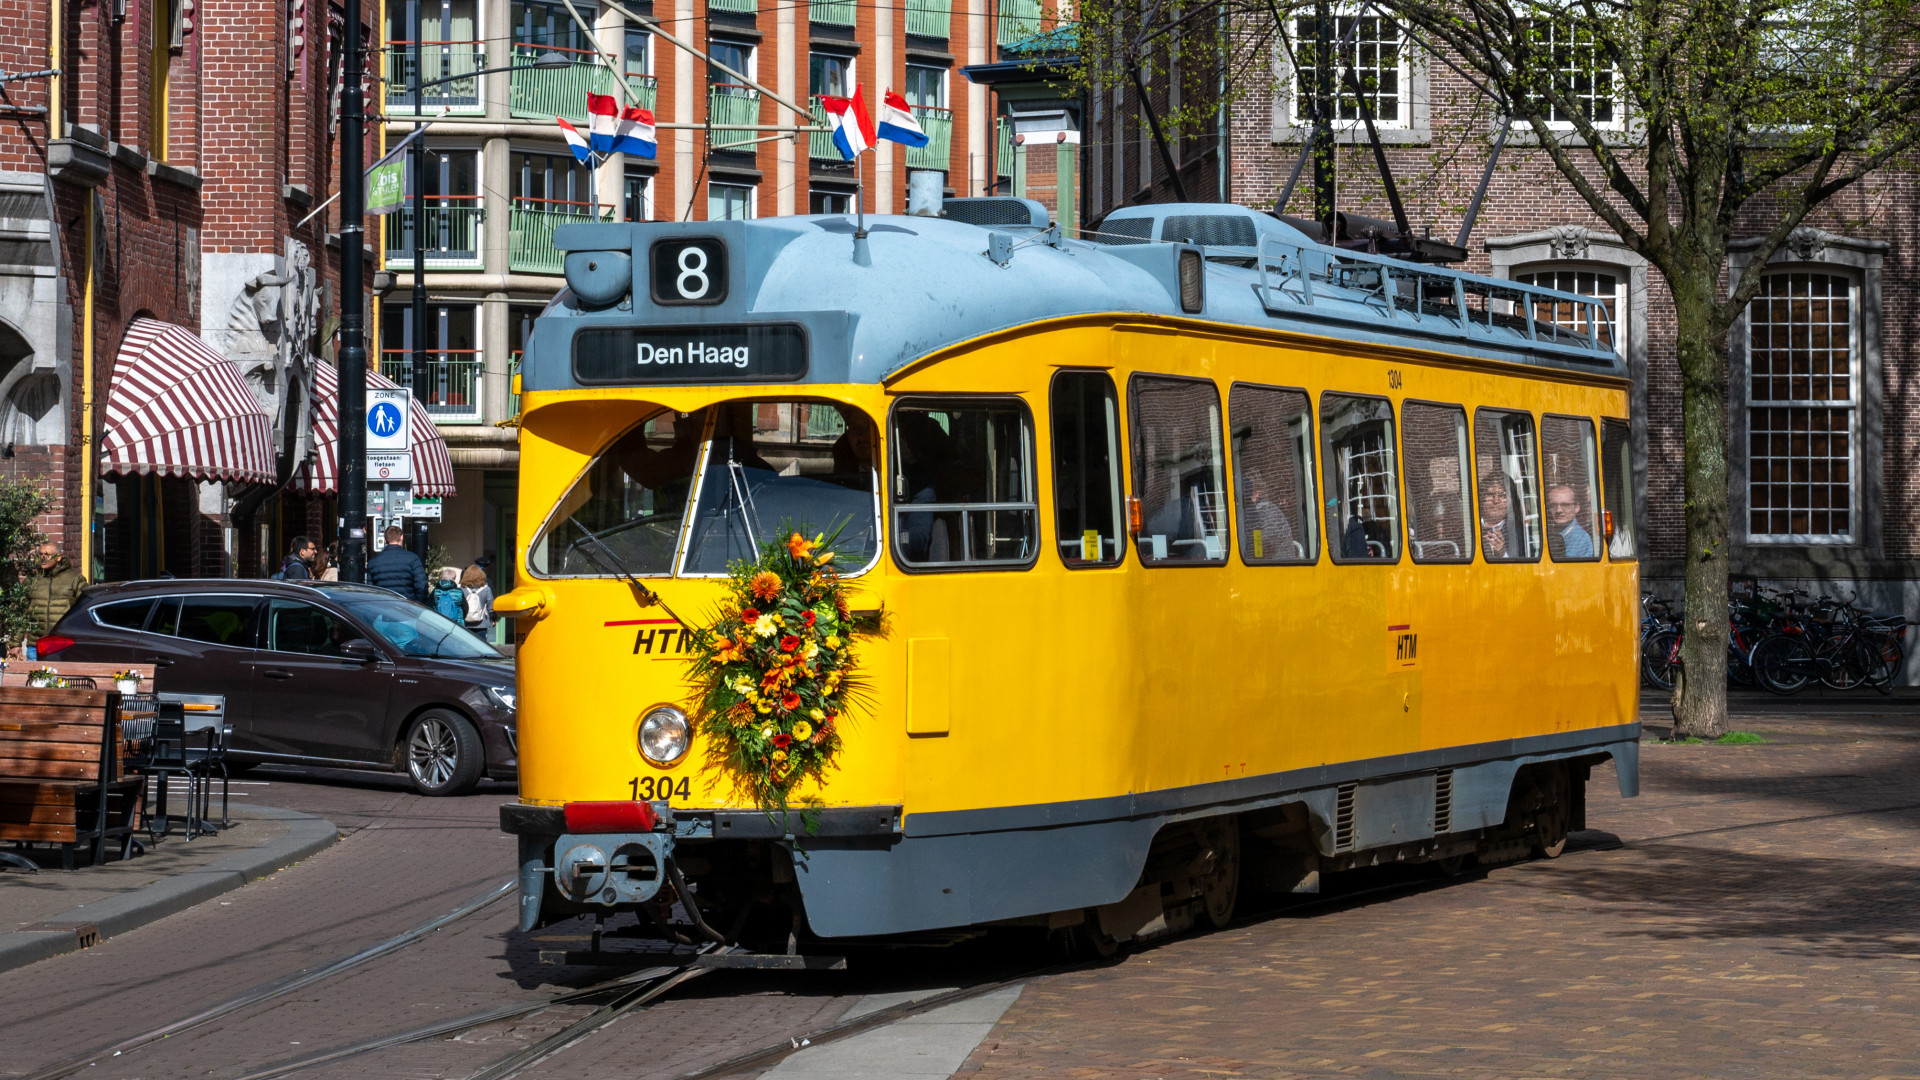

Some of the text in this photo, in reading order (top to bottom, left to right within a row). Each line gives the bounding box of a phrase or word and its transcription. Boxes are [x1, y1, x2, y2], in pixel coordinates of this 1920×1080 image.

[377, 171, 398, 186] ibis
[677, 247, 709, 299] 8
[637, 342, 749, 368] Den Haag
[1388, 369, 1402, 390] 1304
[1397, 634, 1417, 660] HTM
[629, 776, 691, 801] 1304
